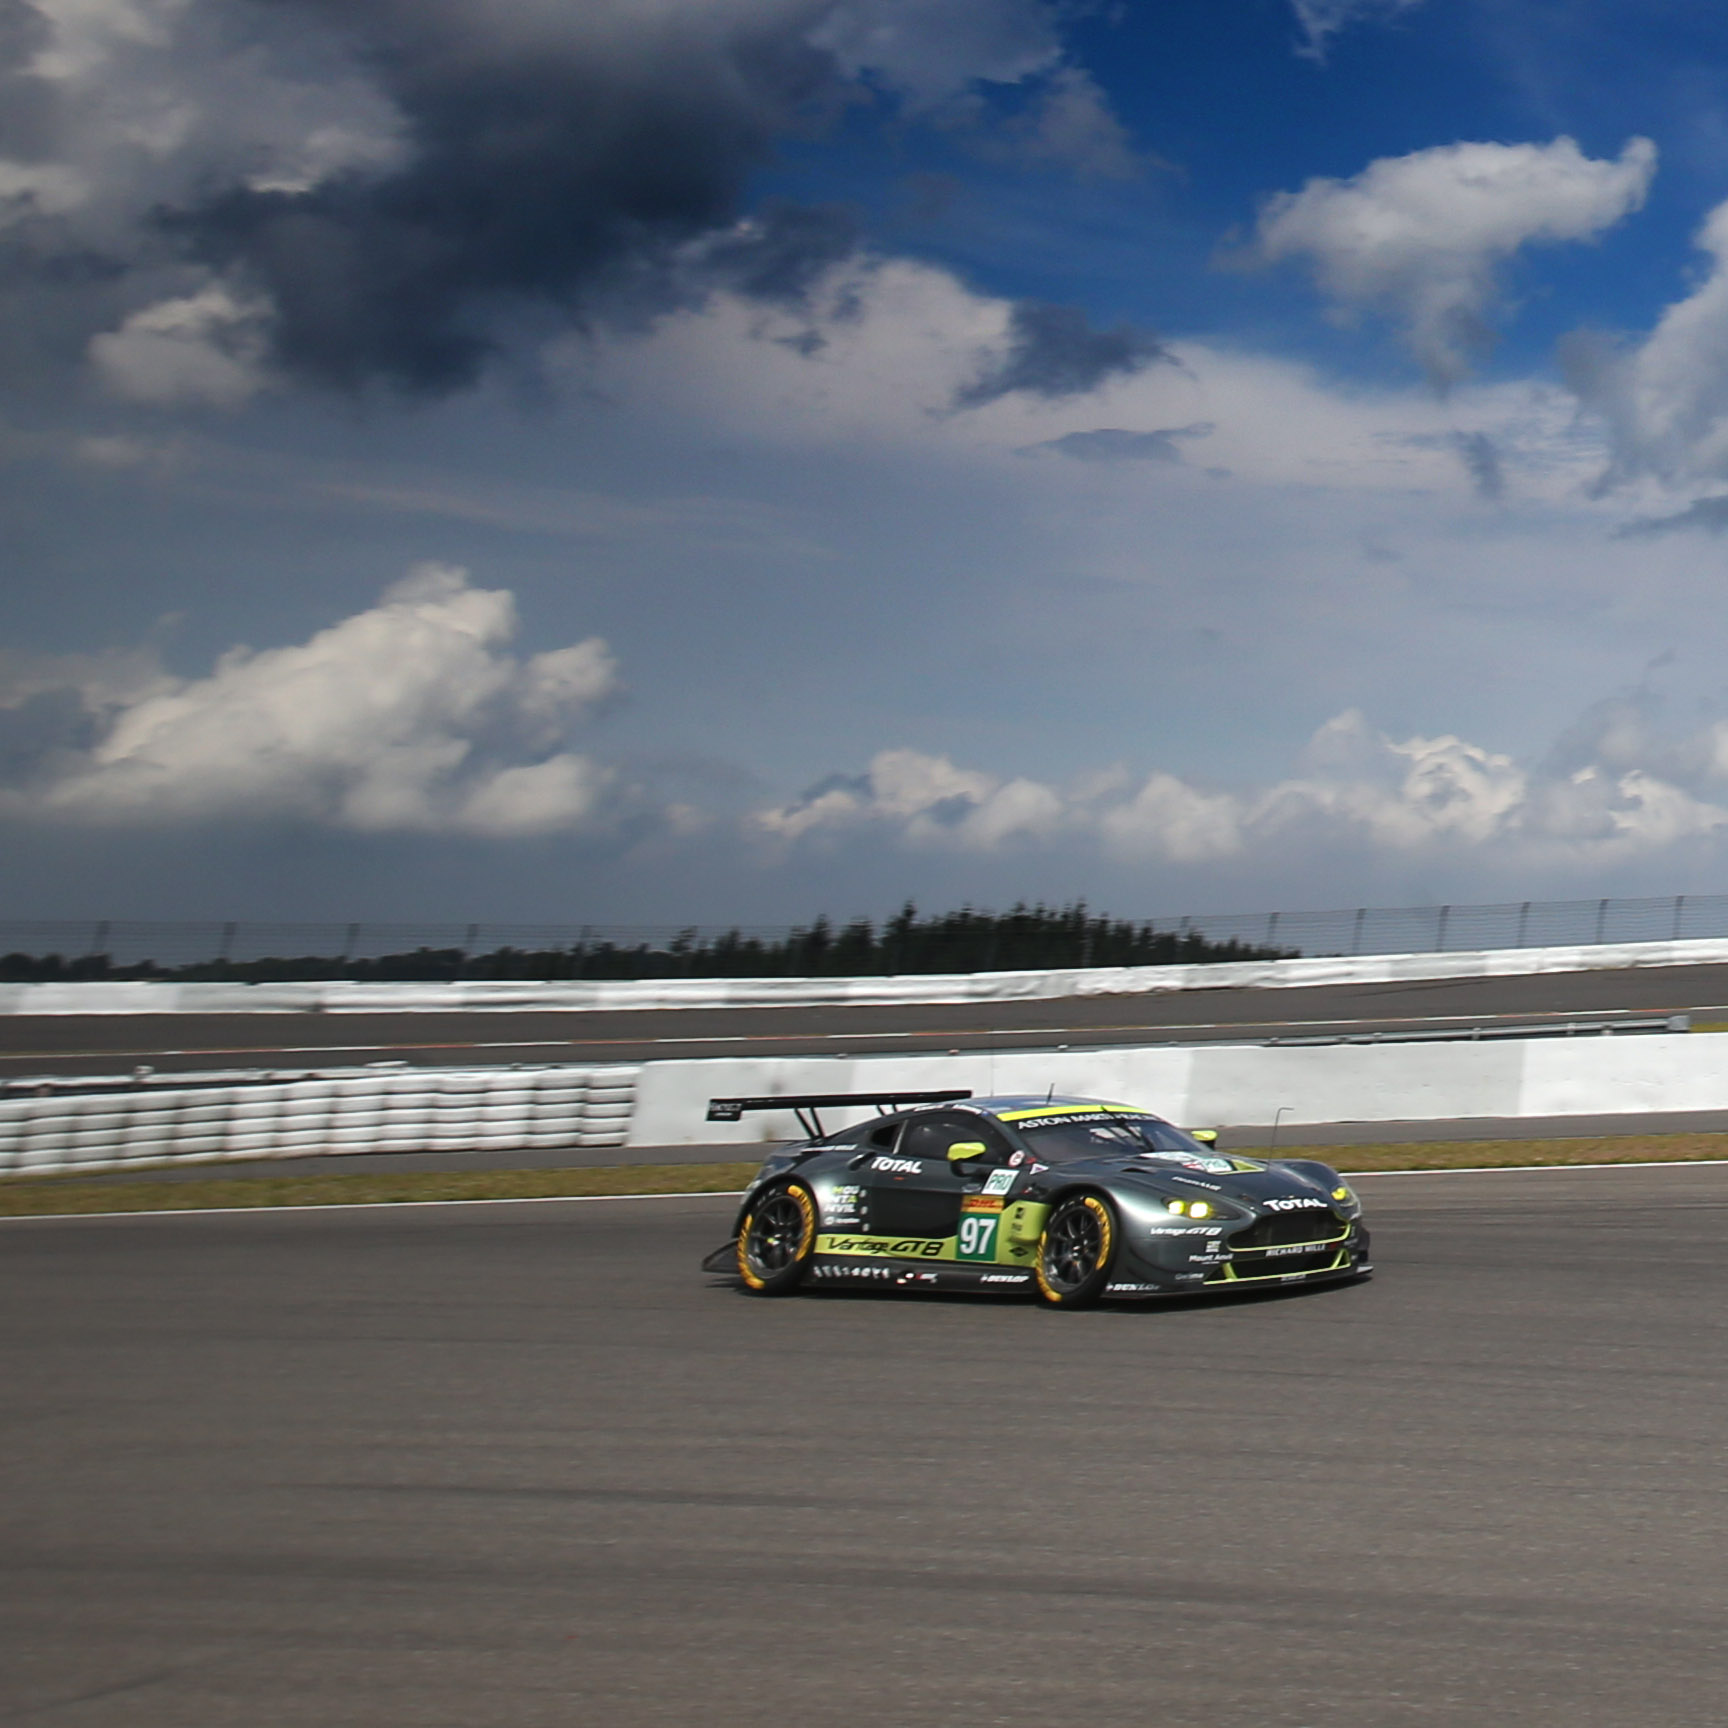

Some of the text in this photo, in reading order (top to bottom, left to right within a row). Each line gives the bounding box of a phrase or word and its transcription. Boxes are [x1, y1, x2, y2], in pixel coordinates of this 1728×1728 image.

[1018, 1116, 1072, 1130] ASTON
[869, 1156, 923, 1174] TOTAL
[1263, 1198, 1328, 1212] TOTAL
[960, 1216, 998, 1255] 97
[826, 1236, 944, 1257] Vantage GT8
